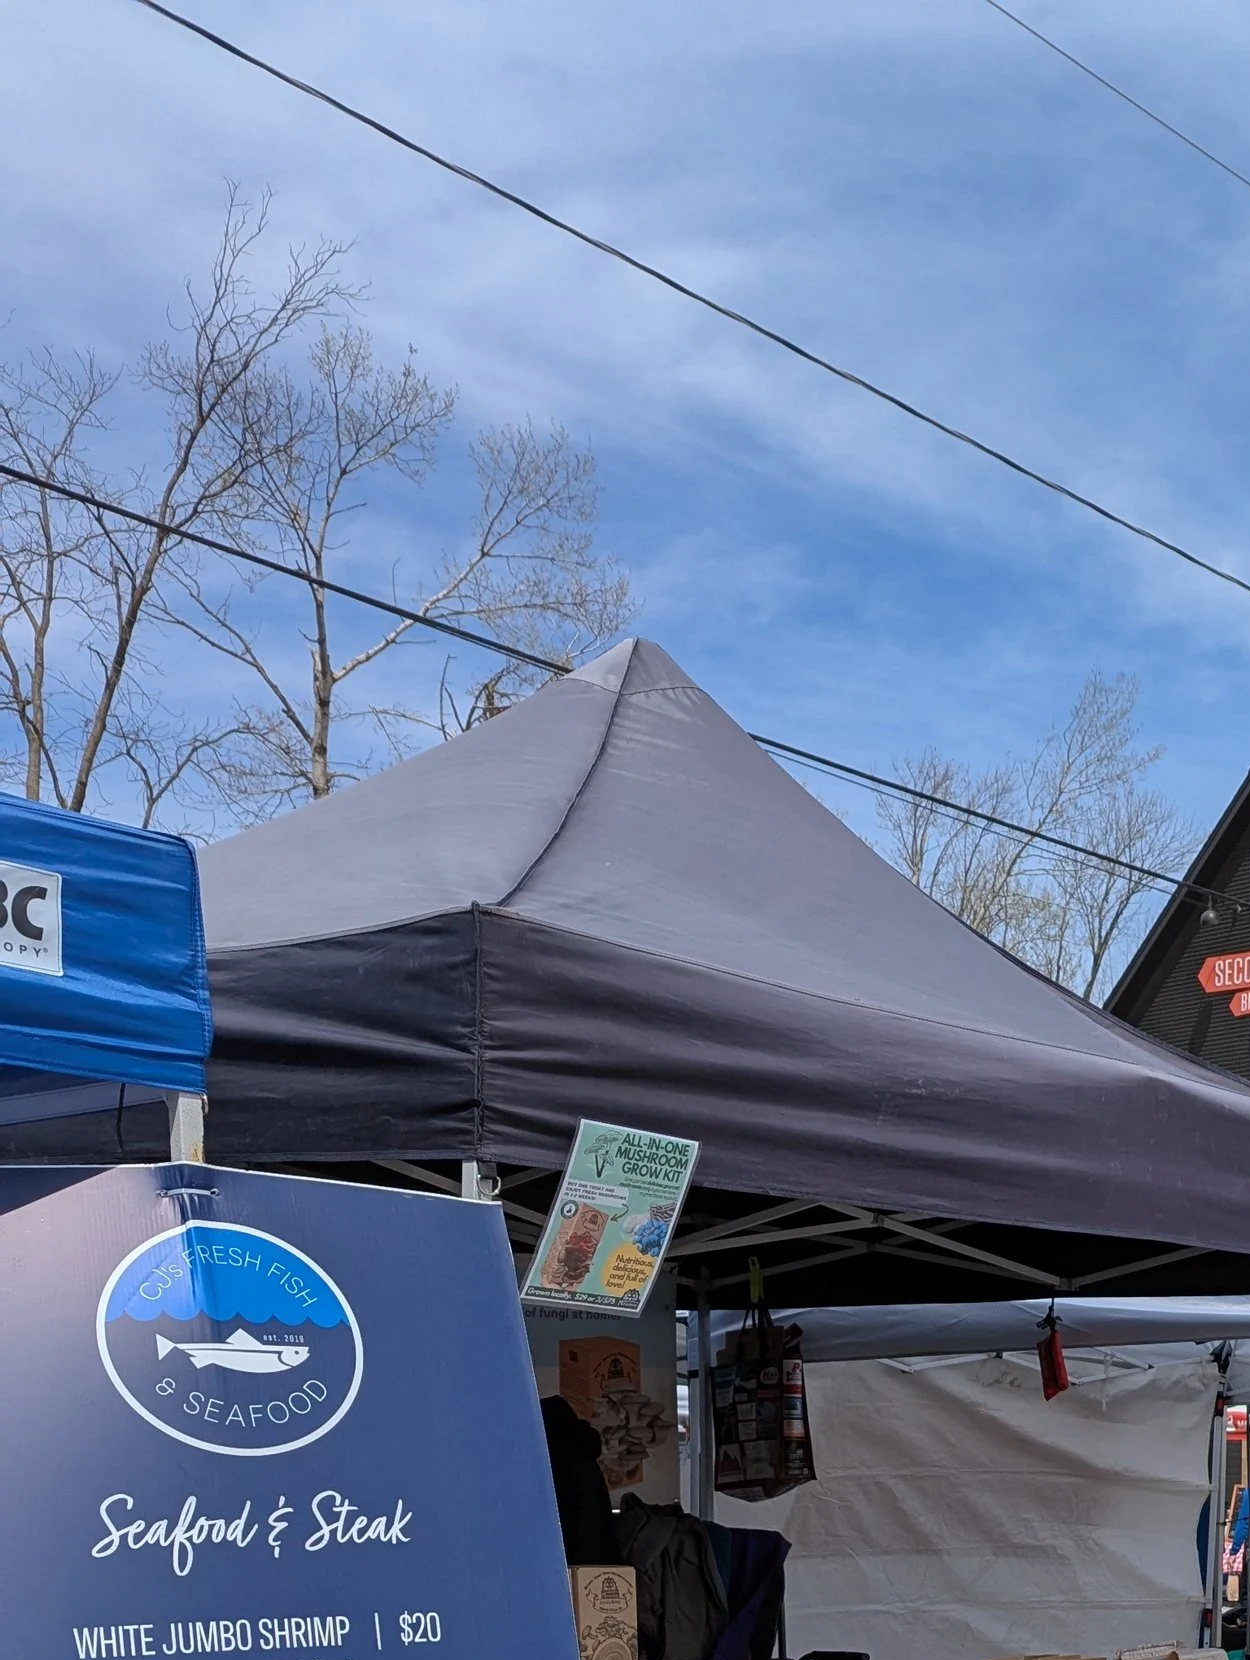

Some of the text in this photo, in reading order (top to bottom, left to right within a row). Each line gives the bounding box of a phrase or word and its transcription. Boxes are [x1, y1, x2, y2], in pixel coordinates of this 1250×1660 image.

[0, 880, 48, 942] C
[621, 1133, 690, 1157] ALL-IN-ONE
[615, 1146, 688, 1170] MUSHROOM
[622, 1162, 683, 1183] GROW KIT
[612, 1264, 647, 1276] delicious,
[615, 1254, 655, 1268] Nutritious,
[181, 1245, 261, 1272] FRESH
[266, 1262, 318, 1308] FISH
[605, 1278, 625, 1289] love!
[626, 1273, 638, 1282] full
[638, 1276, 648, 1284] of
[527, 1287, 550, 1297] Grown
[574, 1293, 588, 1301] $29
[538, 1308, 569, 1320] fungi
[571, 1309, 584, 1318] at
[263, 1333, 281, 1343] est.
[155, 1377, 327, 1428] & SEAFOOD
[91, 1493, 259, 1577] Seafood
[304, 1490, 413, 1552] Steak
[73, 1611, 442, 1660] WHITE JUMBO SHRIMP $20
